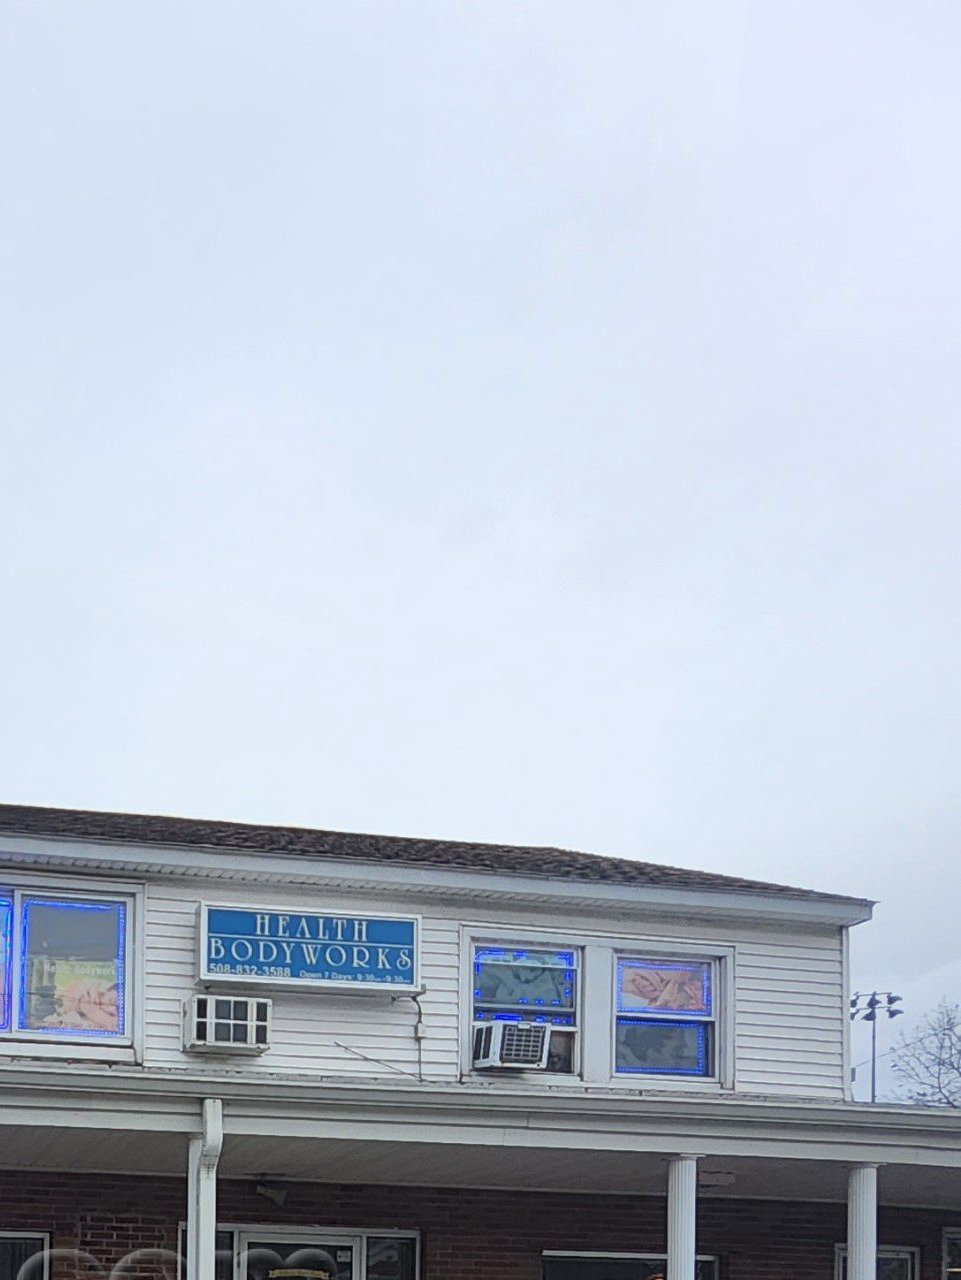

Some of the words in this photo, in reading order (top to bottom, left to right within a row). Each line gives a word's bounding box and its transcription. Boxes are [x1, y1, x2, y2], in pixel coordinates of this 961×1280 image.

[255, 914, 368, 942] HEALTH
[209, 938, 412, 970] BODYWORKS
[209, 963, 291, 978] 508-832-3588
[299, 970, 322, 979] Open
